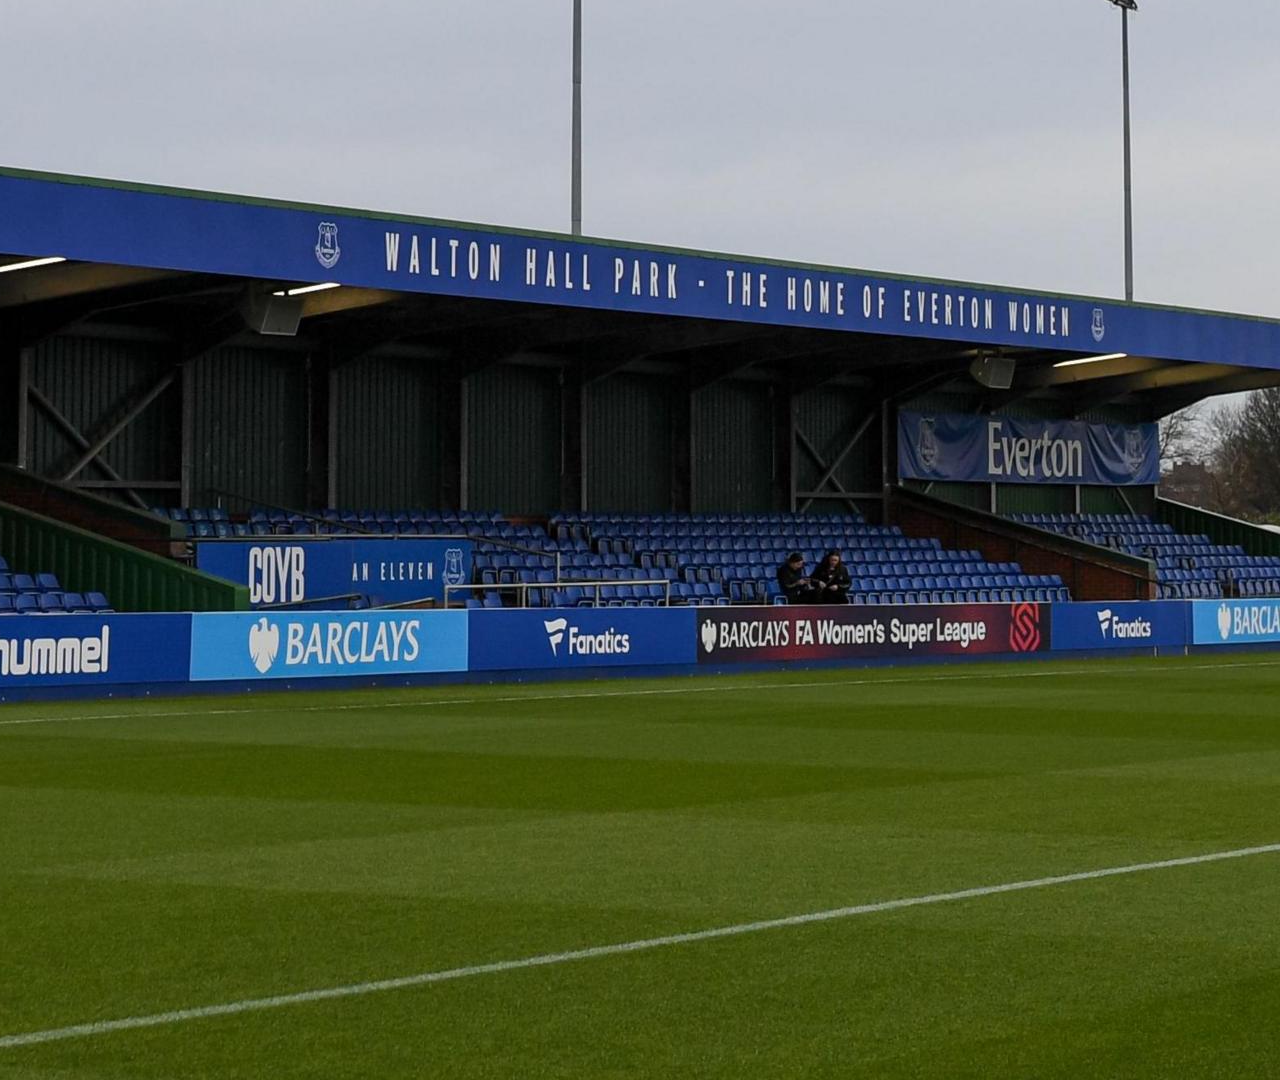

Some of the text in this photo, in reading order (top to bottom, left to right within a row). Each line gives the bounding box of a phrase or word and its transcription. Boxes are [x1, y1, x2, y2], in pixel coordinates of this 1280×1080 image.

[385, 231, 501, 282] WALTON
[525, 247, 591, 291] HALL
[614, 257, 678, 299] PARK
[726, 270, 768, 308] THE
[787, 276, 844, 315] HOME
[863, 284, 886, 318] OF
[903, 289, 993, 329] EVERTON
[1008, 301, 1070, 337] WOMEN
[987, 421, 1083, 477] Everton
[248, 546, 305, 603] COYB
[352, 562, 434, 581] AN ELEVEN
[285, 620, 420, 664] BARCLAYS
[568, 627, 630, 655] Fanatics
[719, 617, 986, 649] BARCLAYS FA Women's Super League
[1112, 616, 1151, 638] Fanatics
